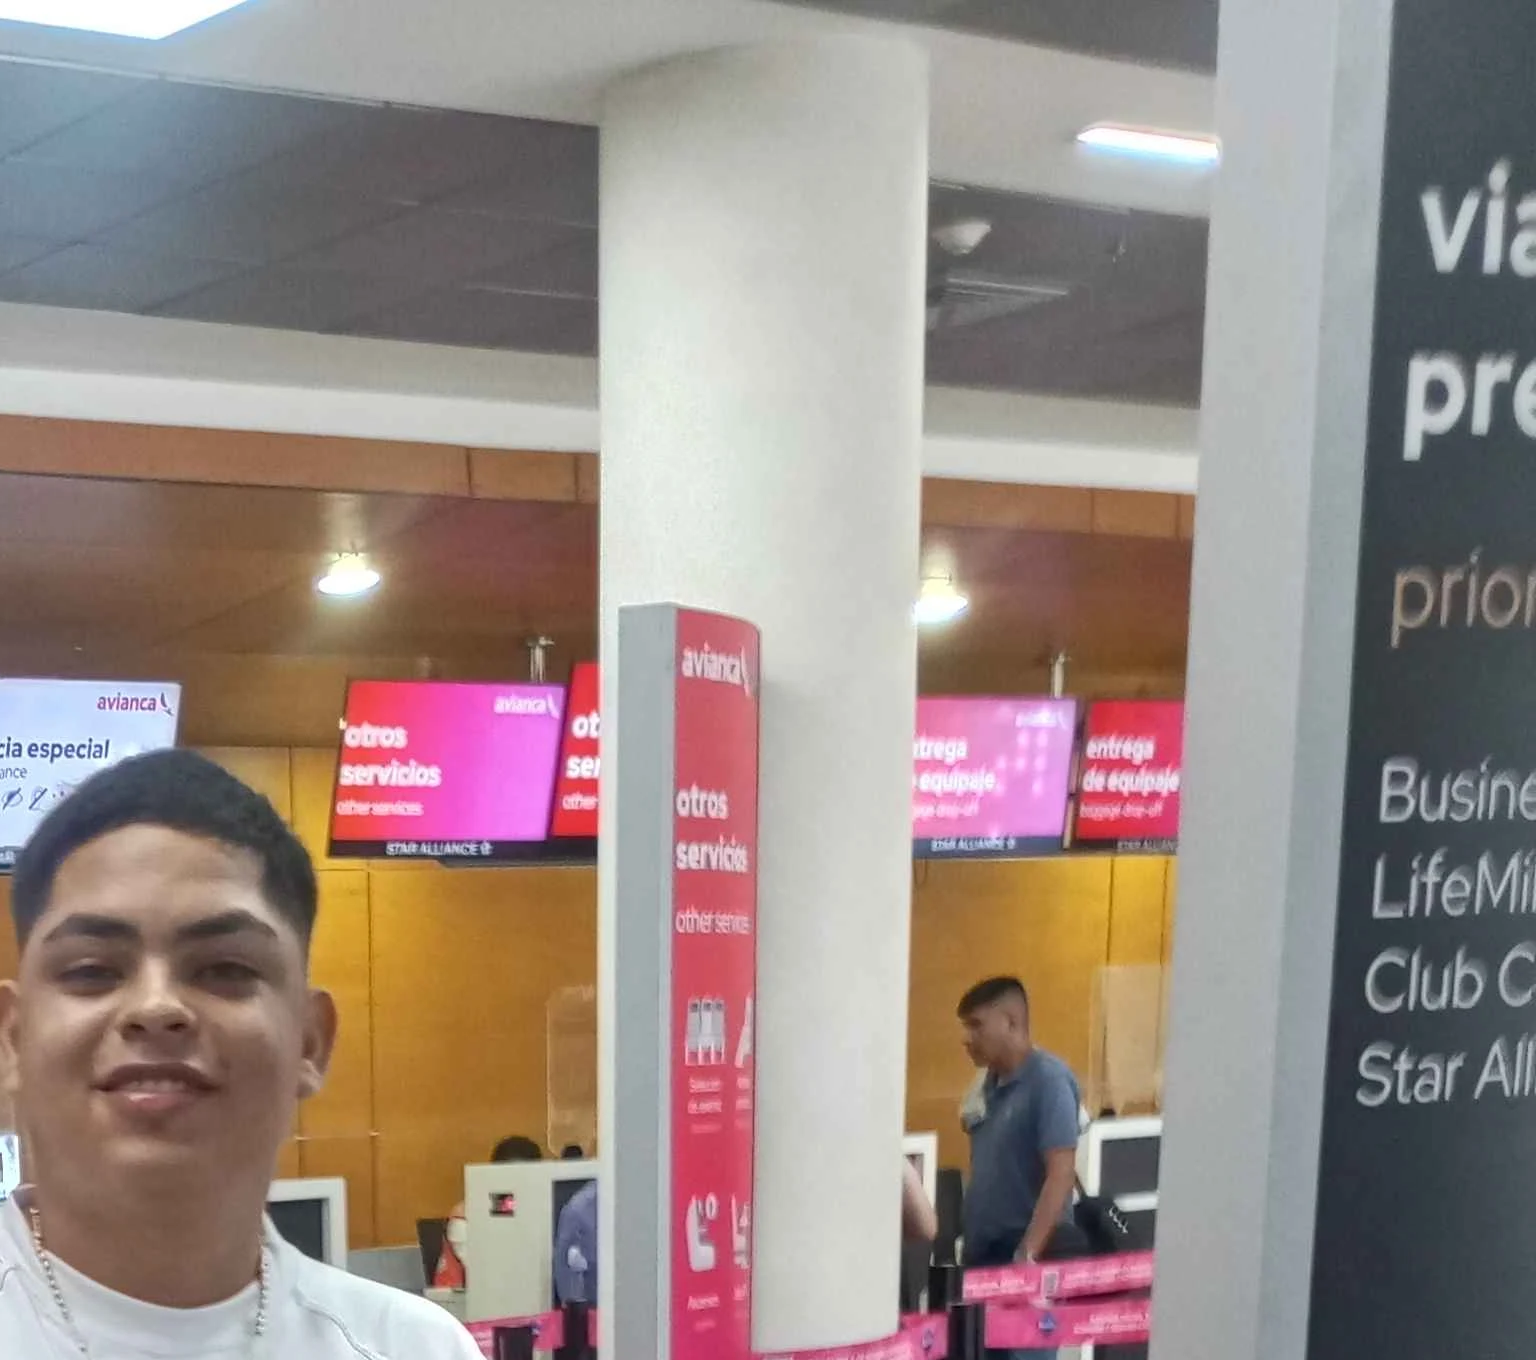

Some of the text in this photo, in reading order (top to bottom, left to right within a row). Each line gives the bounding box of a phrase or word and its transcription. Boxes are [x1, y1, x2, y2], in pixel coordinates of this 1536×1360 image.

[96, 694, 157, 712] avianca
[494, 694, 546, 714] avianca
[344, 721, 409, 749] otros
[27, 738, 110, 764] especial
[1086, 735, 1155, 766] entrega
[339, 758, 442, 787] servicios
[1083, 763, 1105, 793] de
[675, 781, 729, 820] otros
[675, 904, 713, 934] other
[1365, 942, 1487, 1014] Club
[1355, 1031, 1536, 1107] Star All
